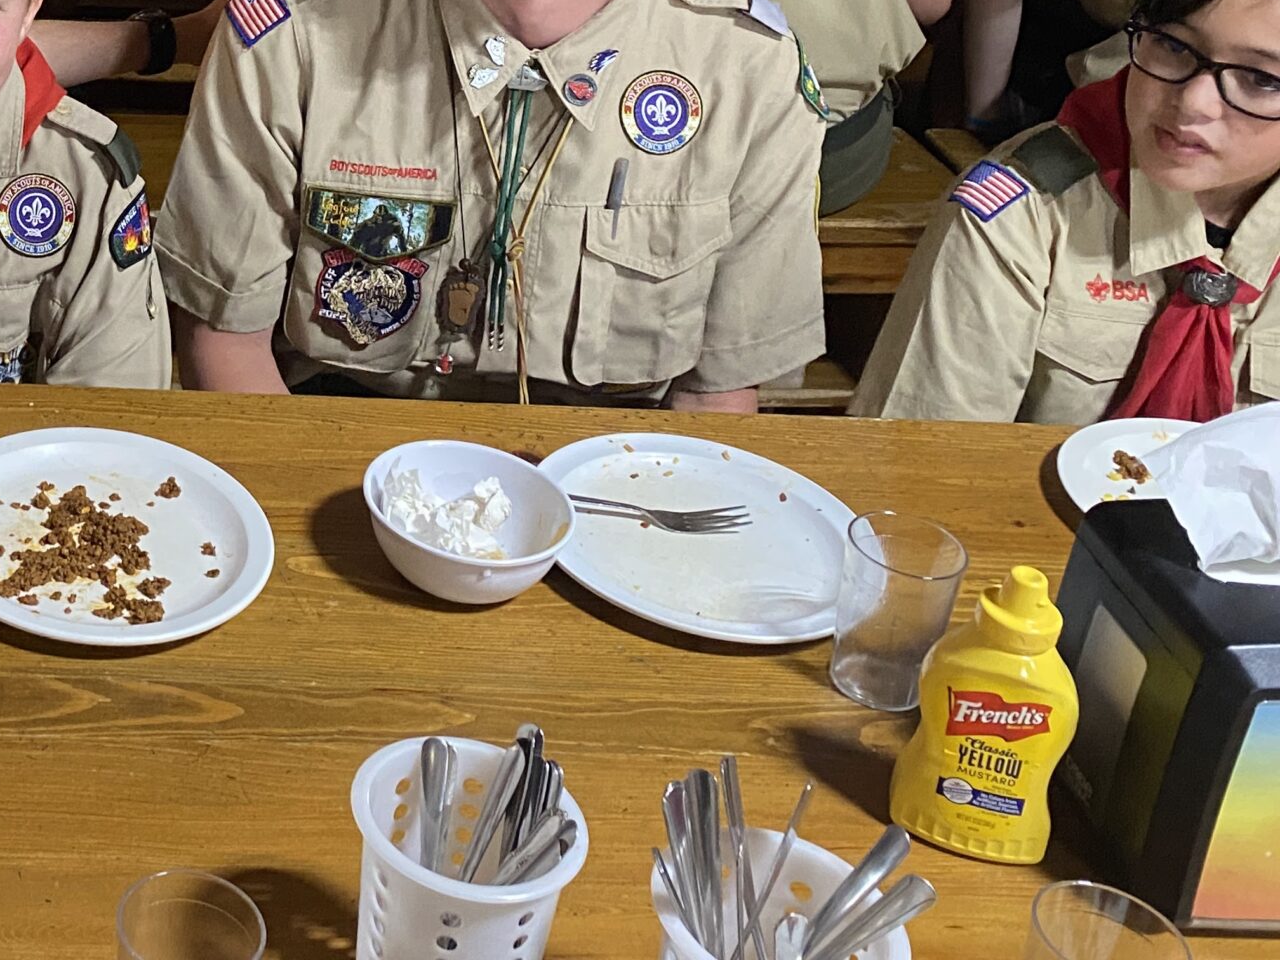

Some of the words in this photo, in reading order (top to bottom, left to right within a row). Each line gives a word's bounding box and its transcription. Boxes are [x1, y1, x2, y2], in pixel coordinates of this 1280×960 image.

[330, 159, 350, 172] BOY
[349, 163, 388, 177] SCOUTS
[397, 167, 438, 181] AMERICA
[1, 189, 14, 205] BOY
[12, 177, 41, 193] SCOUTS
[49, 181, 73, 217] AMERICA
[12, 238, 35, 253] SINCE
[36, 243, 52, 253] 1910
[320, 268, 337, 300] STAFF
[1111, 279, 1149, 302] BSA
[318, 308, 347, 320] 2022
[954, 700, 1045, 725] French's
[965, 737, 1019, 759] Classic
[958, 743, 1023, 780] YELLOW
[956, 765, 1016, 787] MUSTARD
